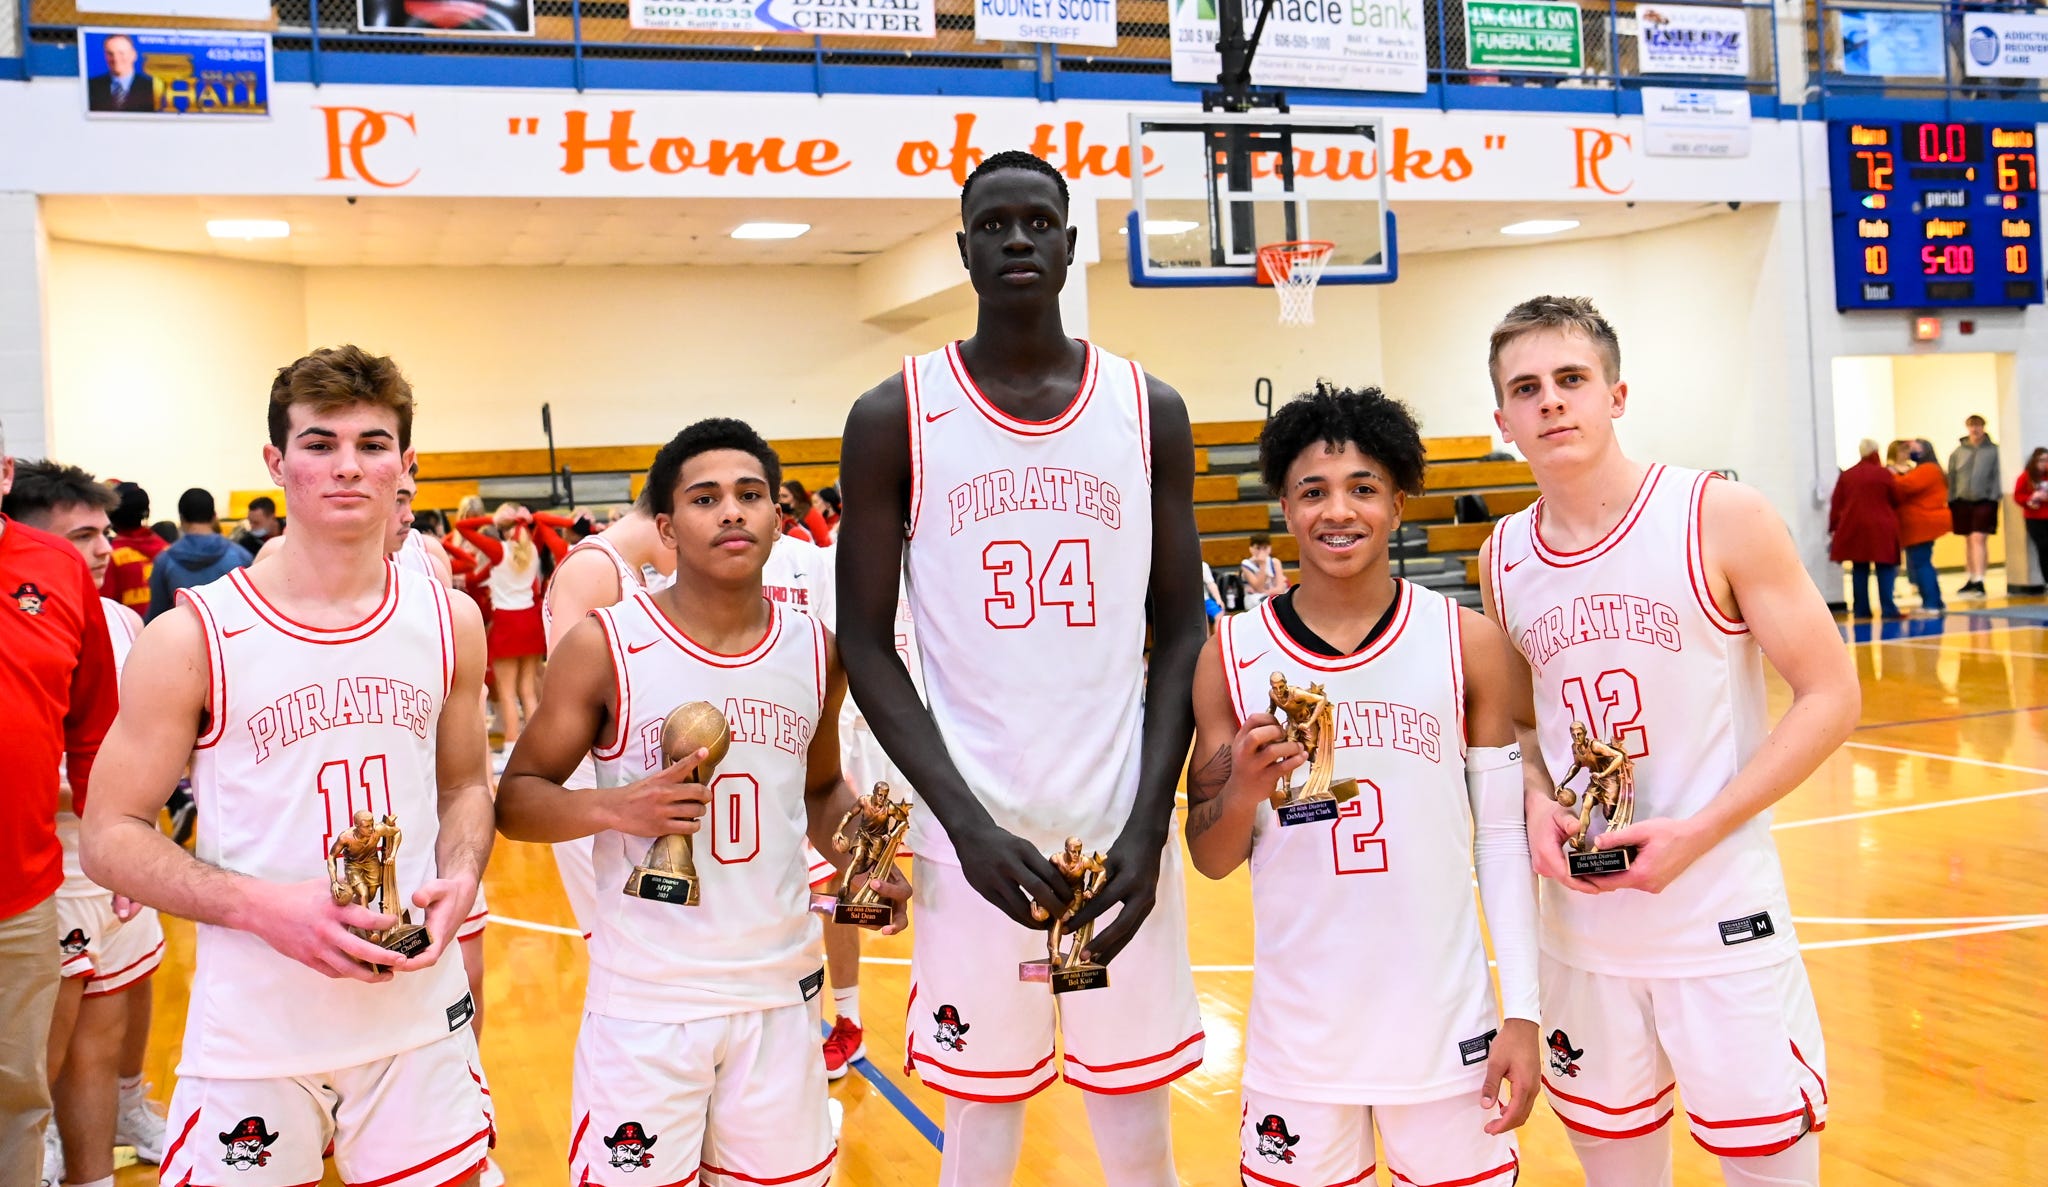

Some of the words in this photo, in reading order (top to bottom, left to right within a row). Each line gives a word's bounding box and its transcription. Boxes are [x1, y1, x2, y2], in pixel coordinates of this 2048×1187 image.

[643, 6, 752, 19] 509-8633
[793, 10, 922, 32] CENTER
[981, 0, 1052, 19] RODNEY
[1058, 0, 1111, 22] SCOTT
[1350, 0, 1414, 31] Bank
[1548, 10, 1574, 30] SON
[1019, 24, 1081, 39] SHERIFF
[1476, 32, 1534, 51] FUNERAL
[1535, 35, 1573, 52] HOME
[313, 106, 421, 188] PC
[896, 112, 984, 187] of
[1028, 121, 1164, 179] the
[1568, 127, 1634, 195] PC
[1919, 124, 1966, 162] 0.0
[1856, 151, 1893, 190] 72
[1998, 153, 2036, 191] 67
[1926, 188, 1965, 209] period
[1865, 246, 1888, 274] 10
[2005, 245, 2028, 274] 10
[948, 467, 1121, 536] PIRATES
[790, 587, 808, 606] THE
[982, 539, 1096, 629] 34
[1521, 594, 1682, 677] PIRATES
[248, 677, 432, 764] PIRATES
[641, 697, 812, 770] PATES
[1334, 701, 1441, 763] ATES
[1562, 668, 1649, 760] 12
[317, 754, 393, 860] 11
[711, 773, 760, 865] 0
[1332, 779, 1389, 875] 2
[662, 877, 679, 885] District
[1756, 920, 1767, 931] M
[400, 940, 422, 954] Chaffin
